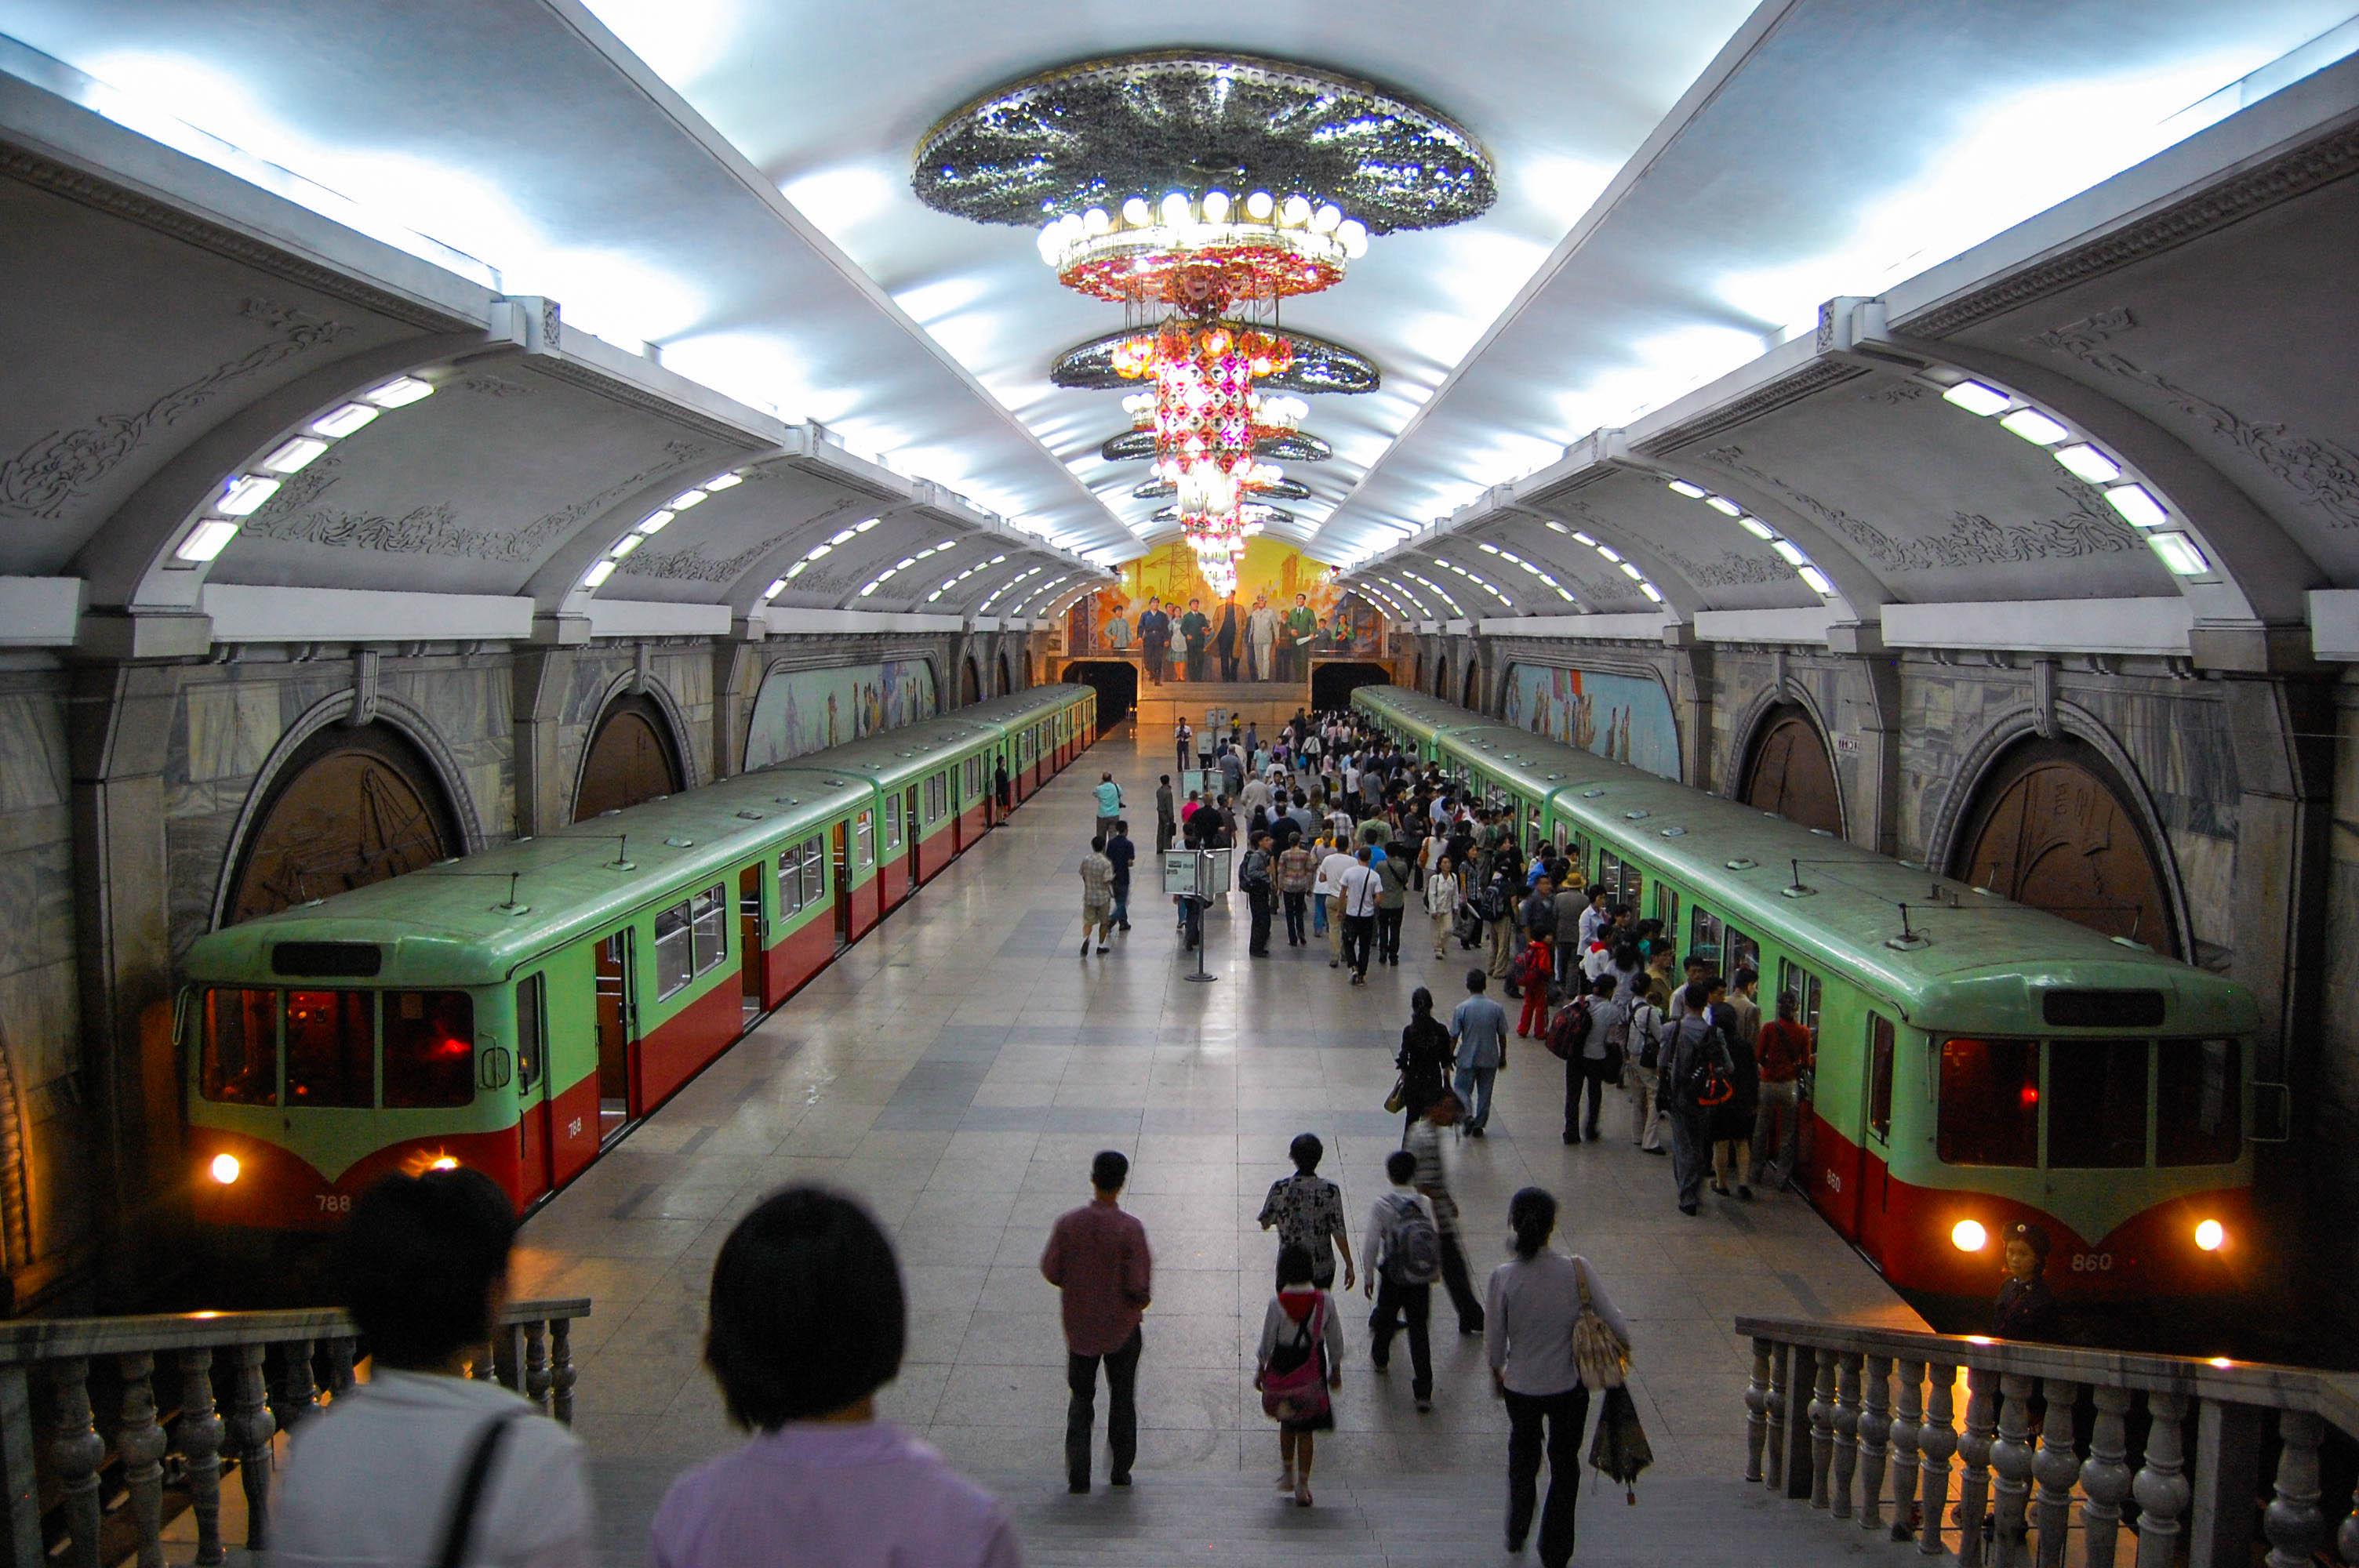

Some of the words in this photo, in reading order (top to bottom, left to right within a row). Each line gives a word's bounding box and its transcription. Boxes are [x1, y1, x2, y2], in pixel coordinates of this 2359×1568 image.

[568, 1116, 582, 1139] 788
[315, 1194, 351, 1212] 788
[2072, 1253, 2112, 1271] 860
